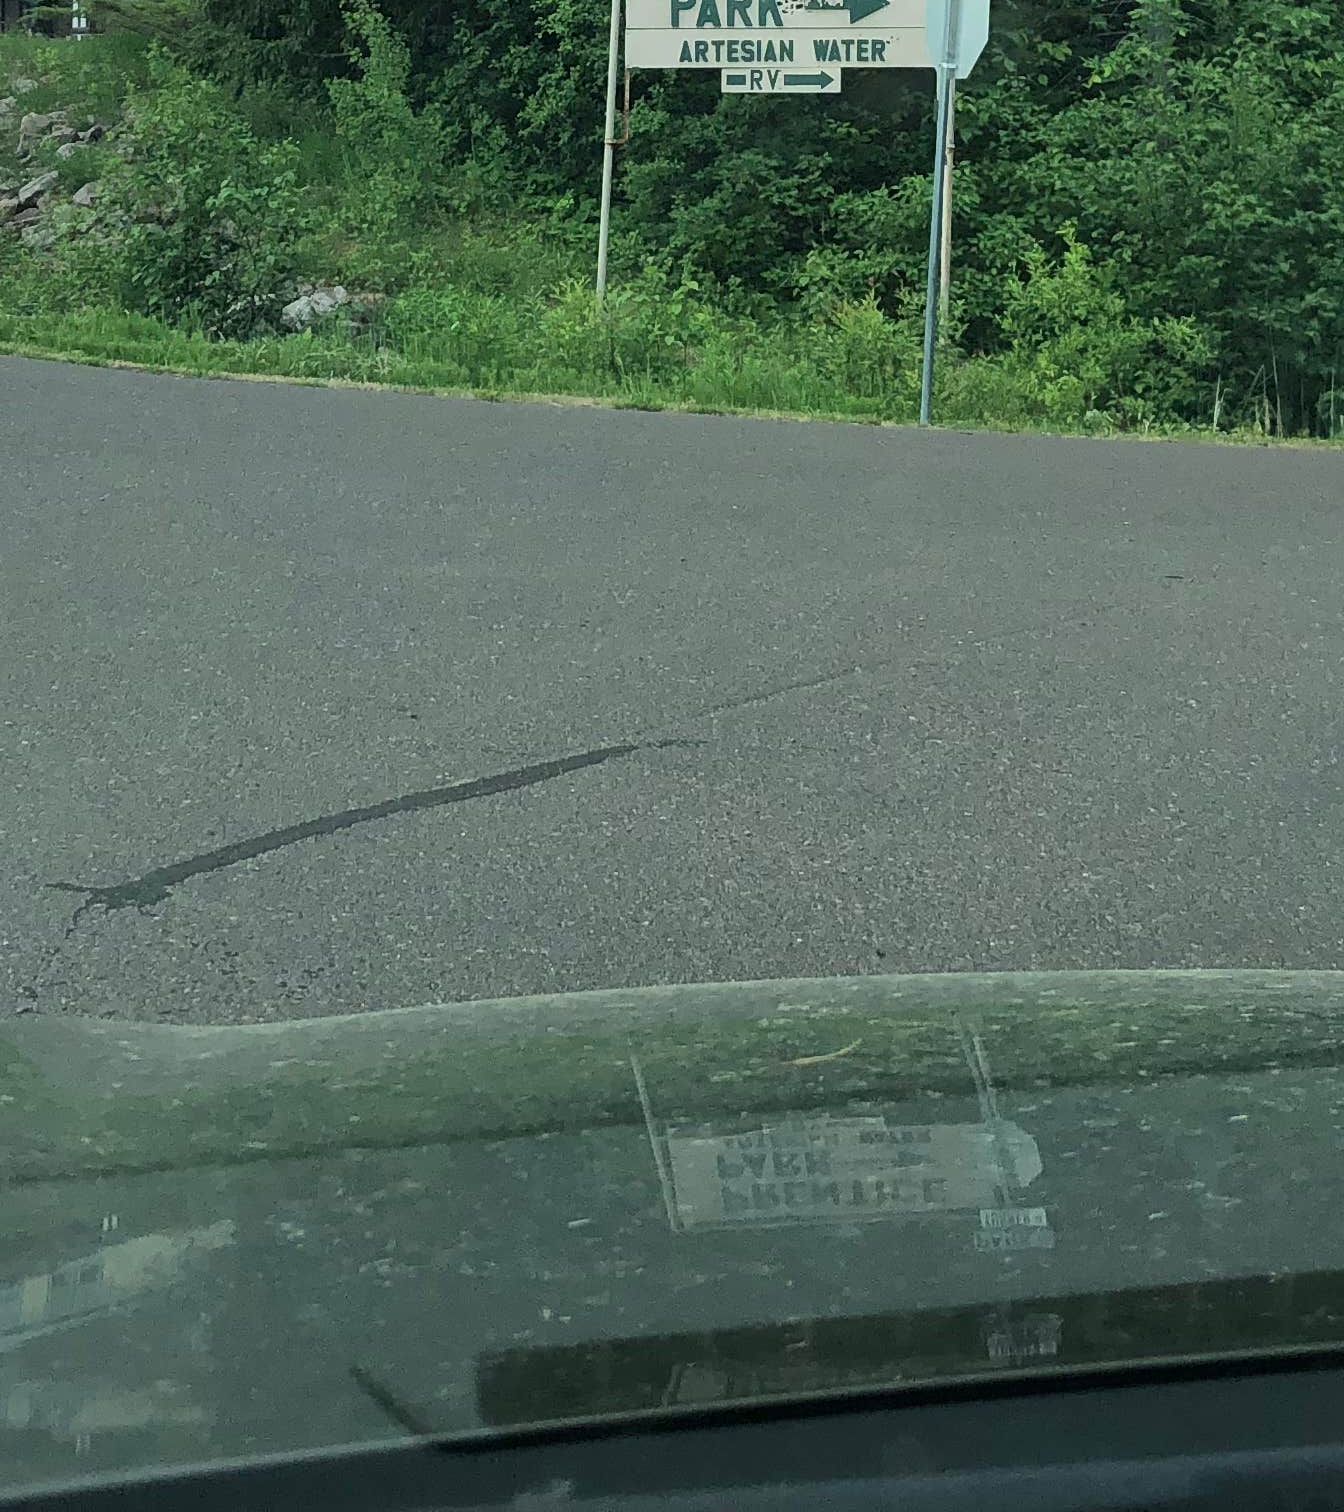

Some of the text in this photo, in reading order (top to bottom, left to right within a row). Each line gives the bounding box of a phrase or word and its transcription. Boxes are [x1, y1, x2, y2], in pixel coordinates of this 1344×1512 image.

[679, 39, 887, 63] ARTESIAN WATER
[750, 69, 782, 91] RV
